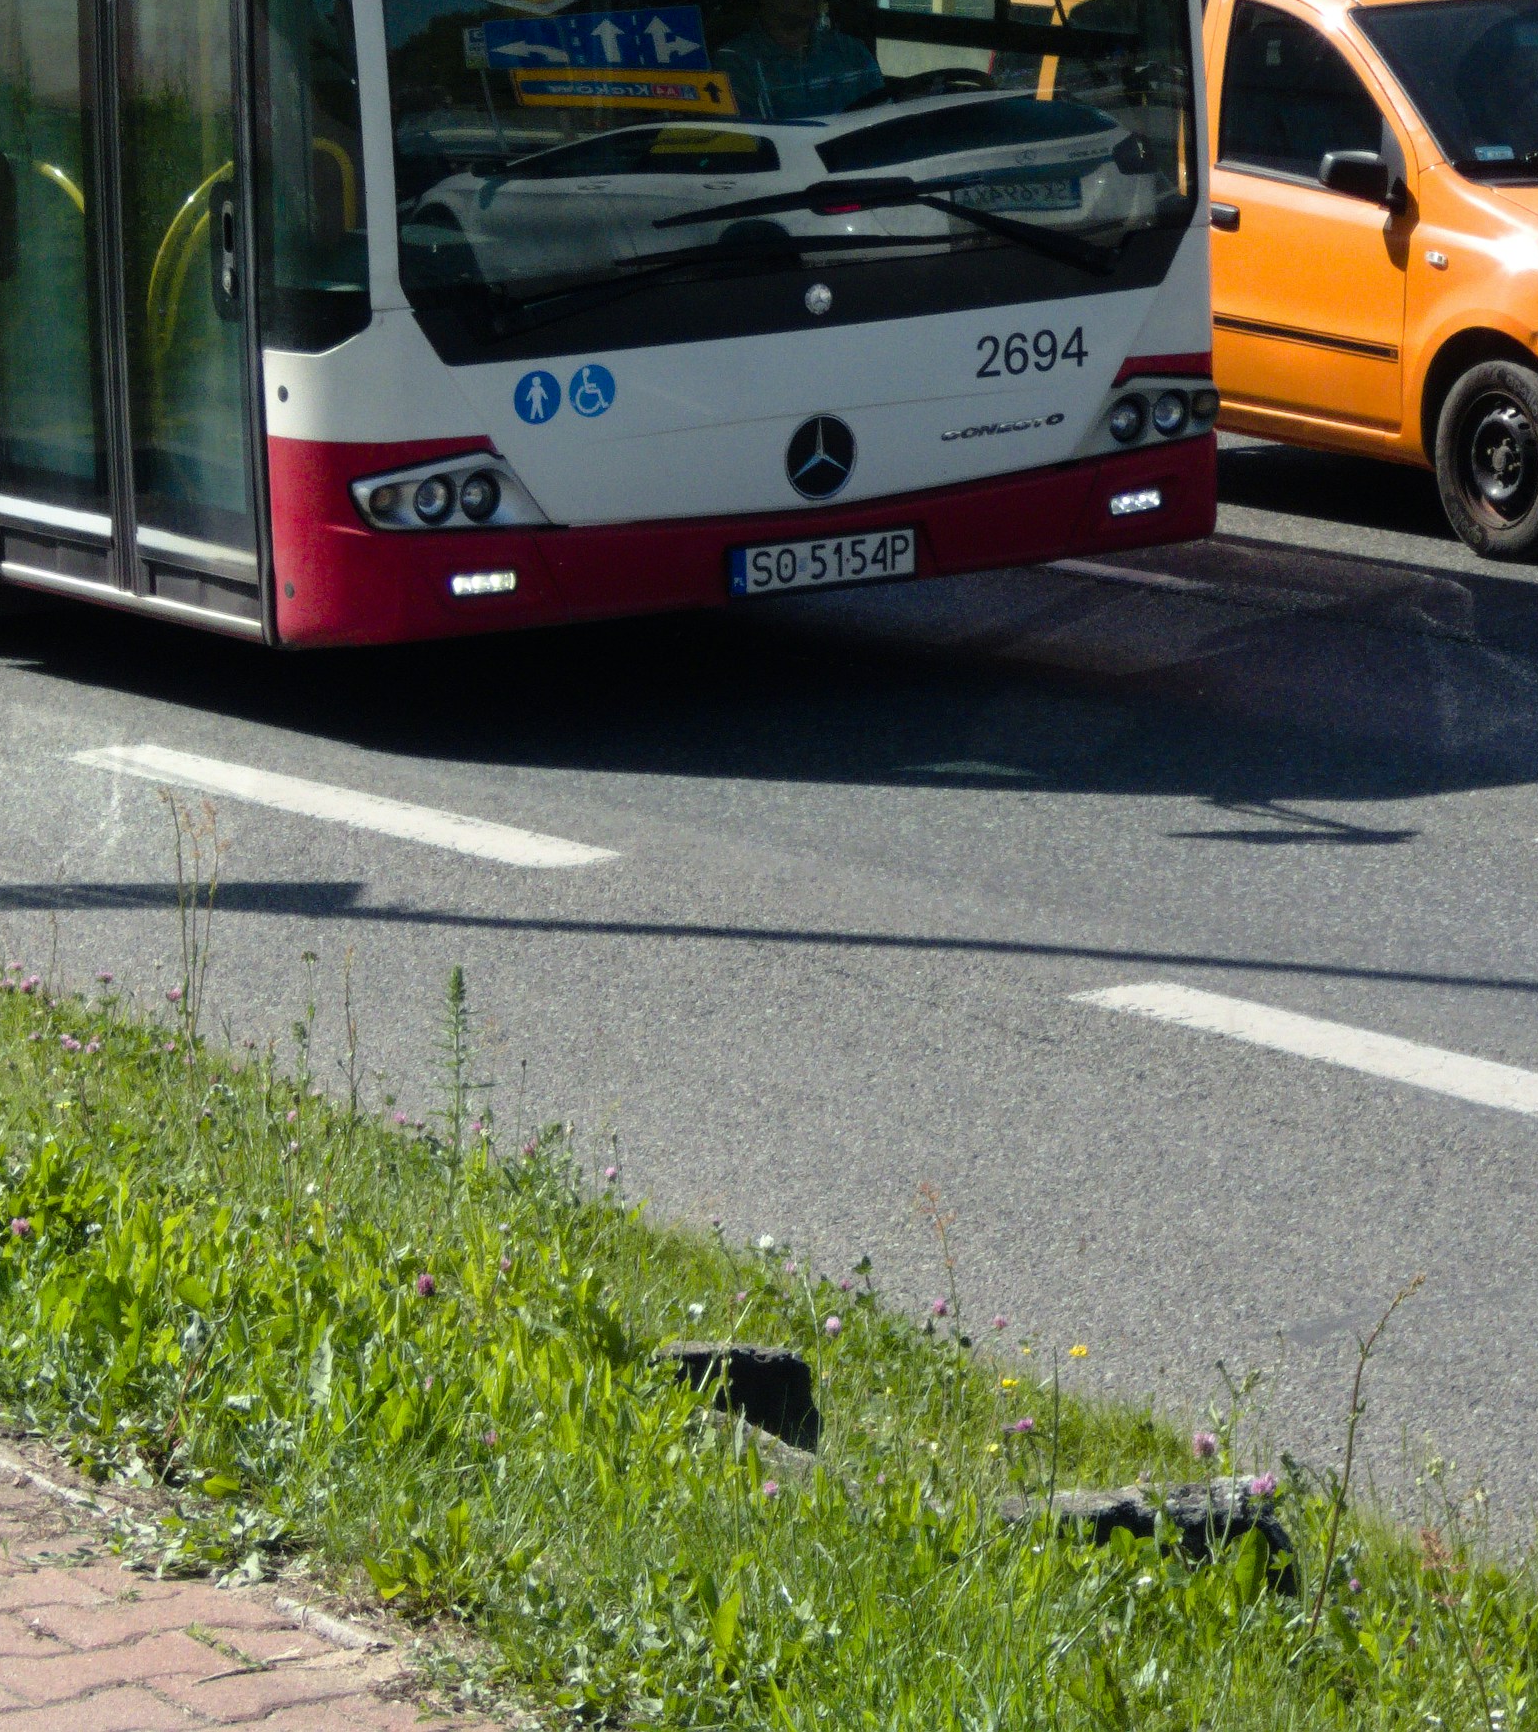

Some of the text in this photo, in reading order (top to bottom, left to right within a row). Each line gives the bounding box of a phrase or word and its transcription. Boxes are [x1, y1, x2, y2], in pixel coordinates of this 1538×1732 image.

[976, 326, 1089, 378] 2694
[752, 534, 910, 587] SO 5154P
